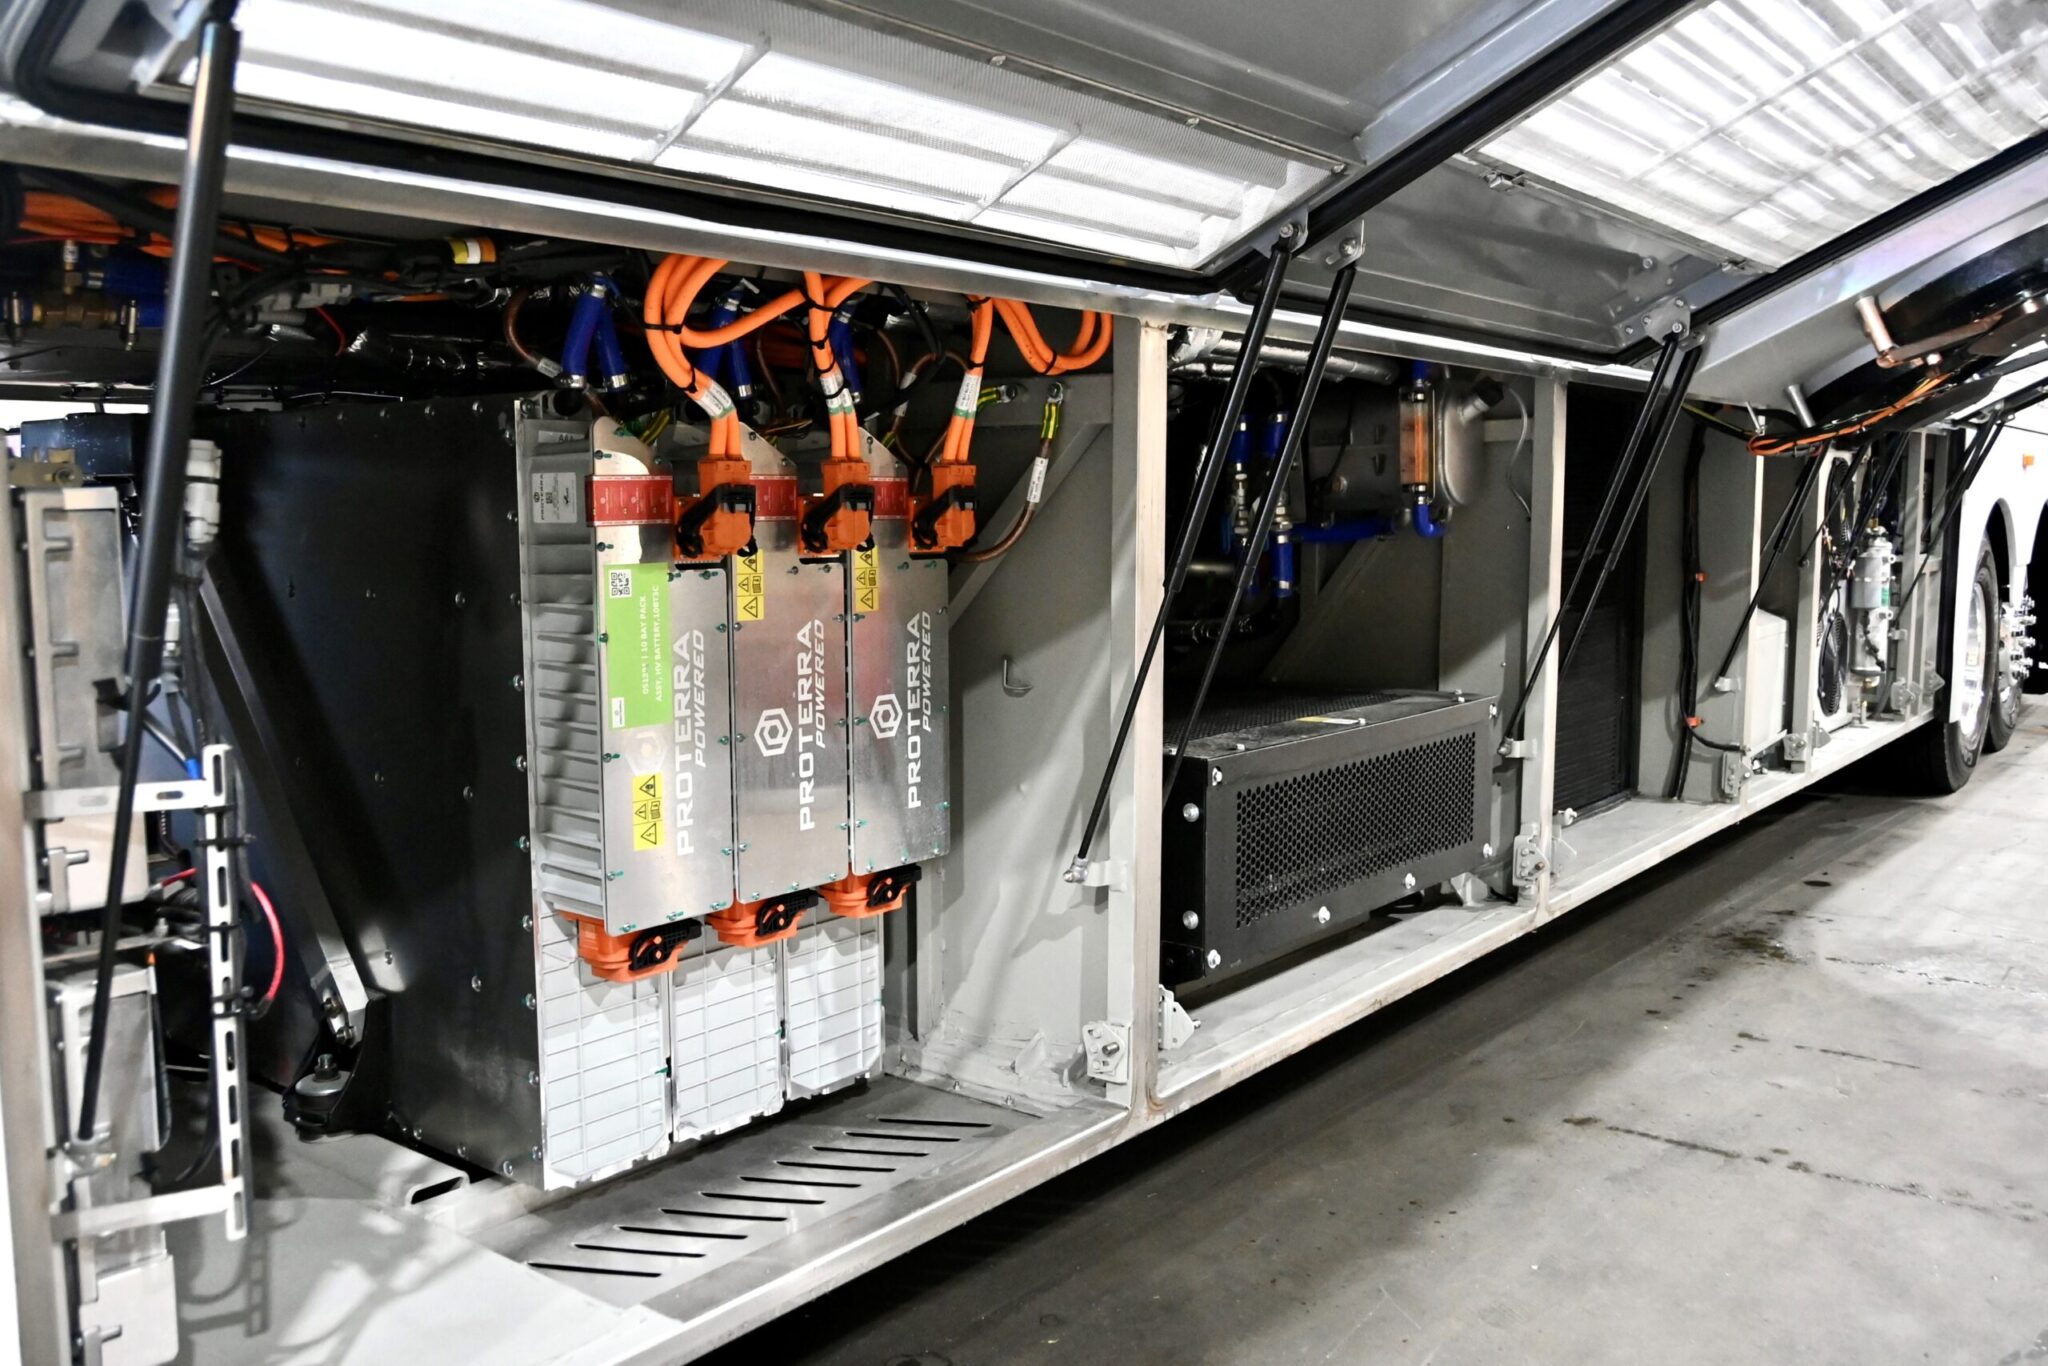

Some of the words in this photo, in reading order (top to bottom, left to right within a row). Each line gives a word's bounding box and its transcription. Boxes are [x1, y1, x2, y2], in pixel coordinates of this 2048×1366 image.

[640, 596, 648, 619] PACK
[921, 611, 932, 733] POWERED
[672, 632, 694, 856] PROTERRA
[692, 629, 707, 768] POWERED
[796, 621, 815, 831] PROTERRA
[813, 619, 826, 749] POWERED
[906, 612, 922, 809] PROTERRA
